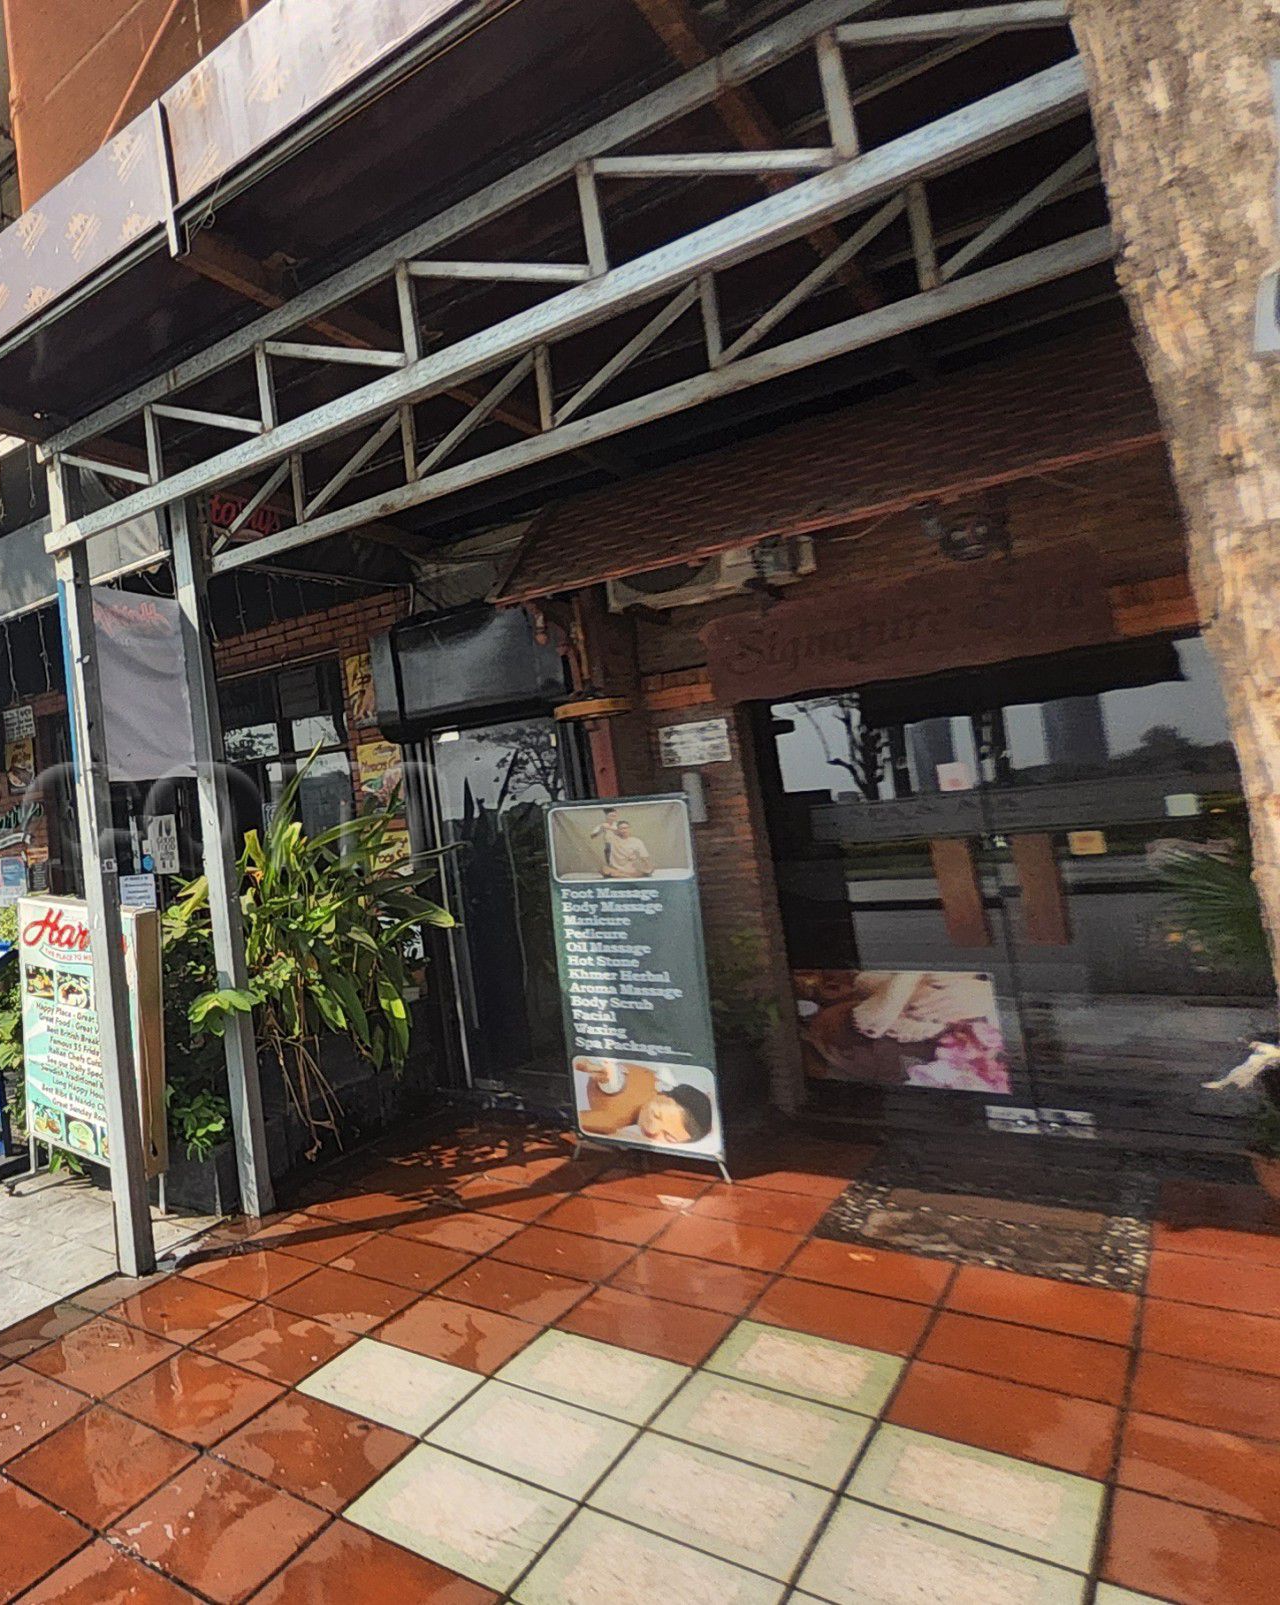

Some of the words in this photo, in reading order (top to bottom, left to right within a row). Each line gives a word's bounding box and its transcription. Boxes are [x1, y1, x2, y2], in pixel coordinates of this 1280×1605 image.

[560, 888, 595, 899] Foot
[596, 888, 660, 901] Massage
[561, 901, 598, 914] Body
[600, 902, 663, 915] Massage
[563, 915, 631, 926] Manicure
[564, 928, 629, 940] Pedicure
[566, 942, 588, 953] Oil
[589, 942, 652, 957] Massage
[567, 955, 595, 966] Hot
[596, 956, 640, 968] Stone
[568, 968, 618, 980] Khmer
[619, 970, 671, 983] Herbal
[568, 982, 618, 994] Aroma
[619, 984, 683, 1000] Massage
[570, 995, 609, 1010] Body
[609, 997, 655, 1010] Scrub
[571, 1008, 617, 1022] Facial
[573, 1022, 628, 1039] Waxing
[575, 1036, 603, 1051] Spa
